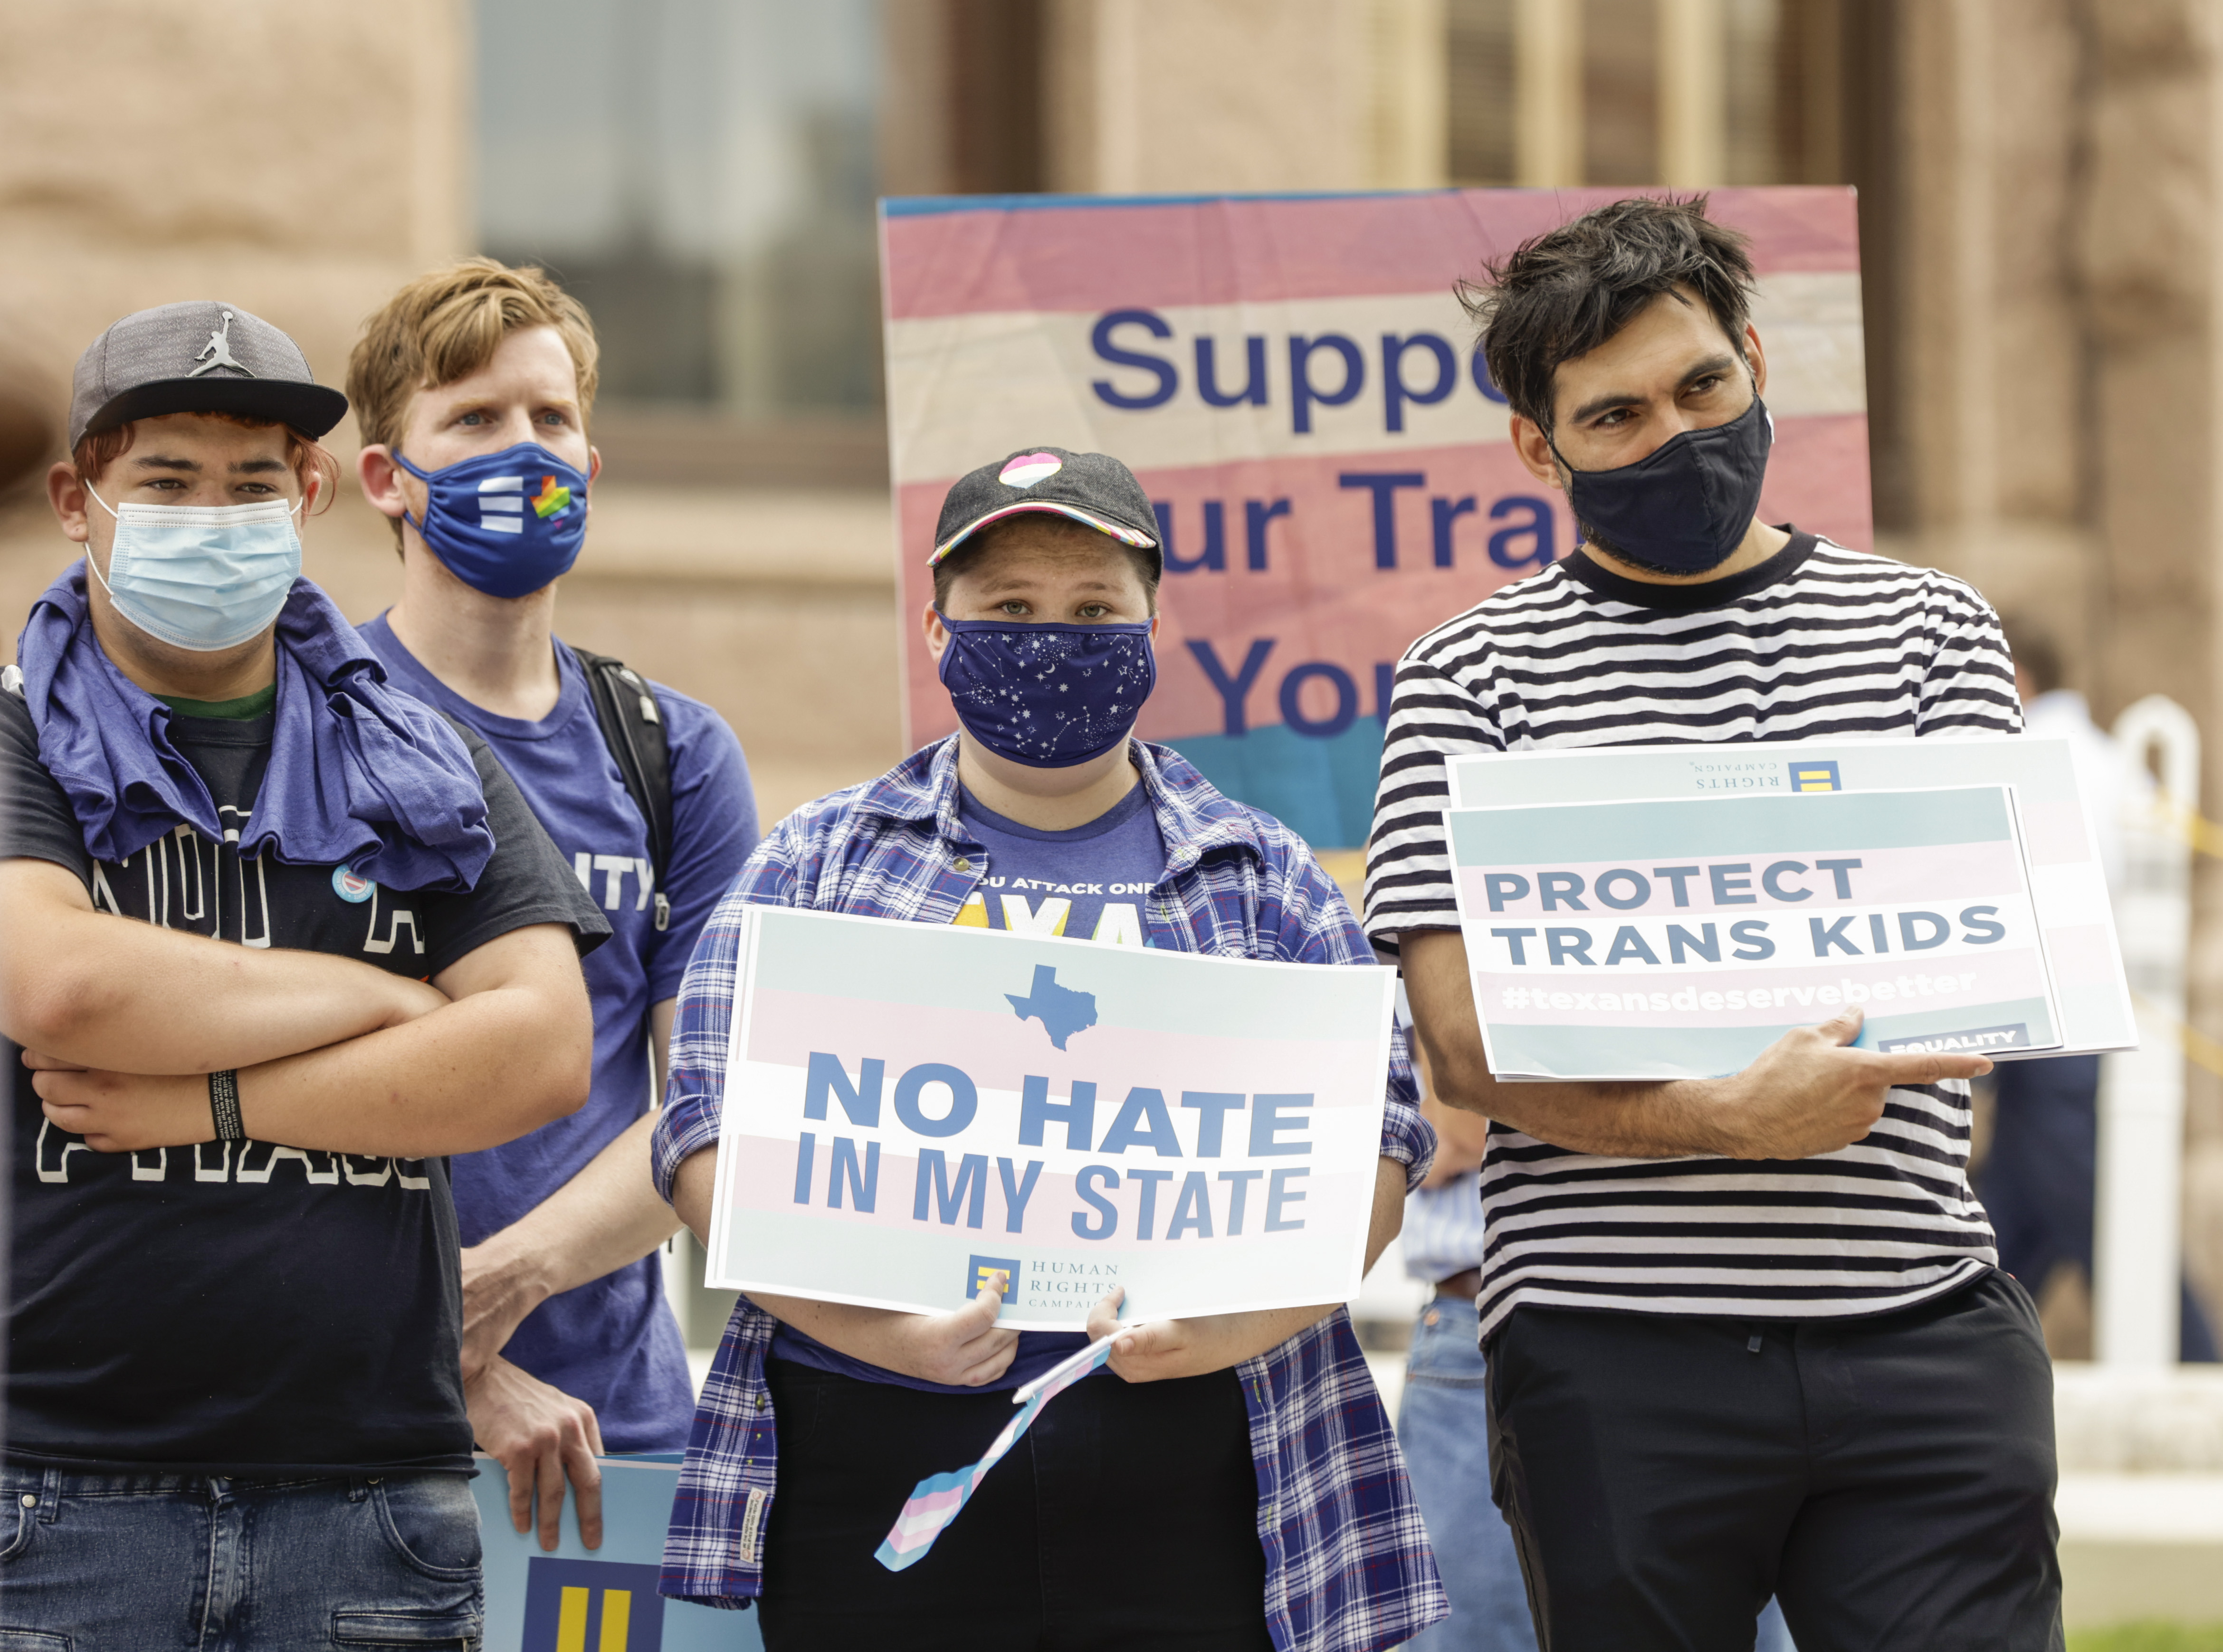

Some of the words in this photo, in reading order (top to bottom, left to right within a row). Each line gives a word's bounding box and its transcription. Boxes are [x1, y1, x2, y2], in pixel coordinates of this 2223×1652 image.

[1152, 496, 1291, 574] ur
[1337, 470, 1584, 570] Tra
[1696, 776, 1780, 789] RIGHTS
[574, 852, 655, 911] ITY
[977, 876, 1006, 888] OU
[1011, 878, 1103, 894] ATTACK
[1483, 858, 1863, 912] PROTECT
[1490, 919, 1776, 965] TRANS
[1808, 905, 2005, 958] KIDS
[1502, 970, 1977, 1012] #texansdeservebetter
[223, 1089, 228, 1097] be
[803, 1051, 978, 1138] NO
[1018, 1075, 1315, 1158] HATE
[793, 1131, 881, 1214] IN
[913, 1147, 1044, 1234] MY
[1071, 1165, 1310, 1241] STATE
[1030, 1280, 1116, 1294] RIGHTS
[1031, 1261, 1119, 1275] HUMAN
